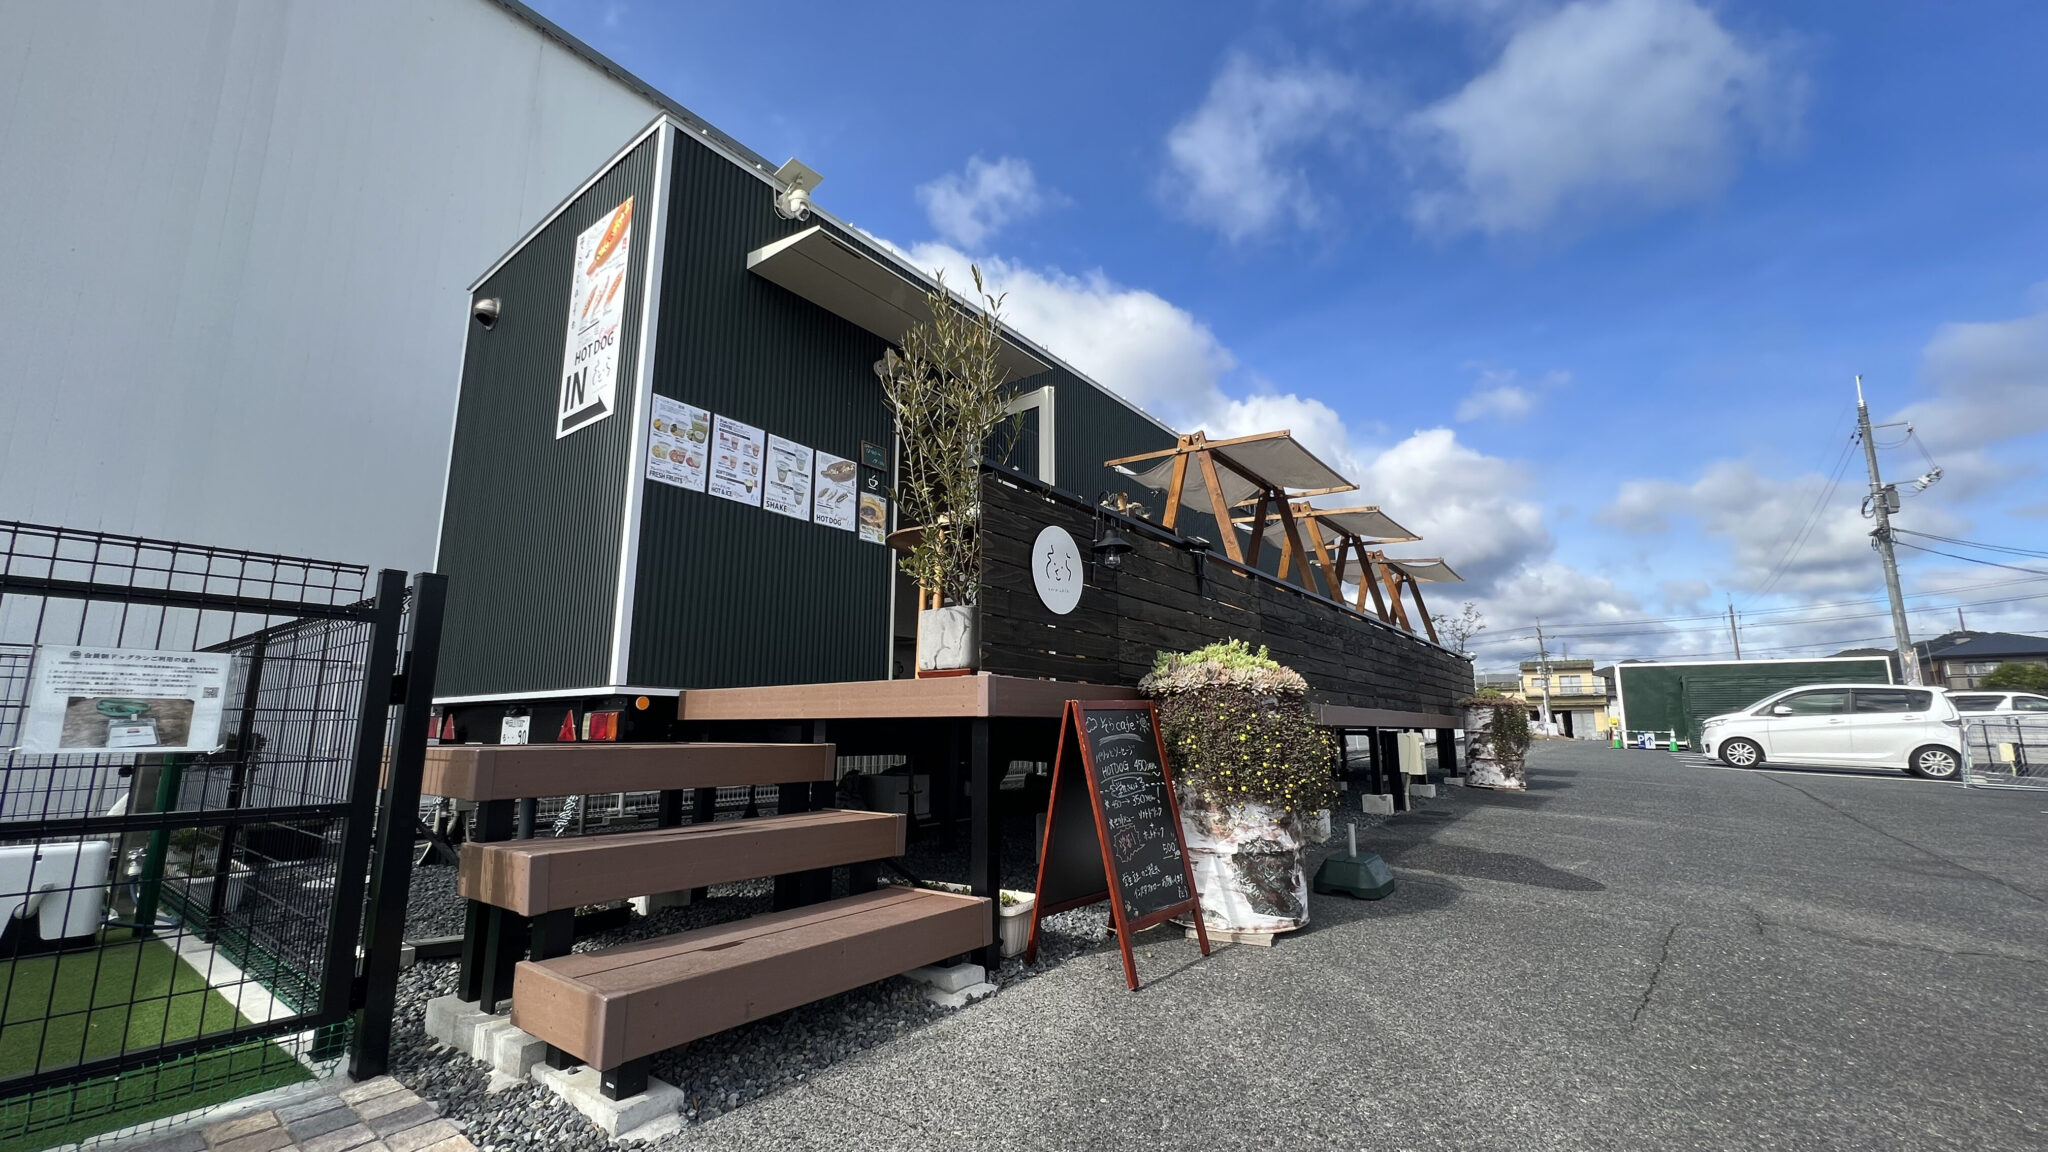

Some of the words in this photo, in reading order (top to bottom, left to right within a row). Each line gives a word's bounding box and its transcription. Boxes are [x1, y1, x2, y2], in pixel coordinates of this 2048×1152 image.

[574, 343, 593, 366] HOT
[594, 331, 614, 355] DOG
[563, 366, 588, 413] IN
[649, 470, 665, 479] FRESH
[666, 474, 683, 484] FRUITS
[711, 486, 719, 494] HOT
[766, 501, 787, 512] SHAKE
[816, 514, 828, 523] HOT
[829, 517, 842, 526] DOG
[1637, 734, 1645, 746] P
